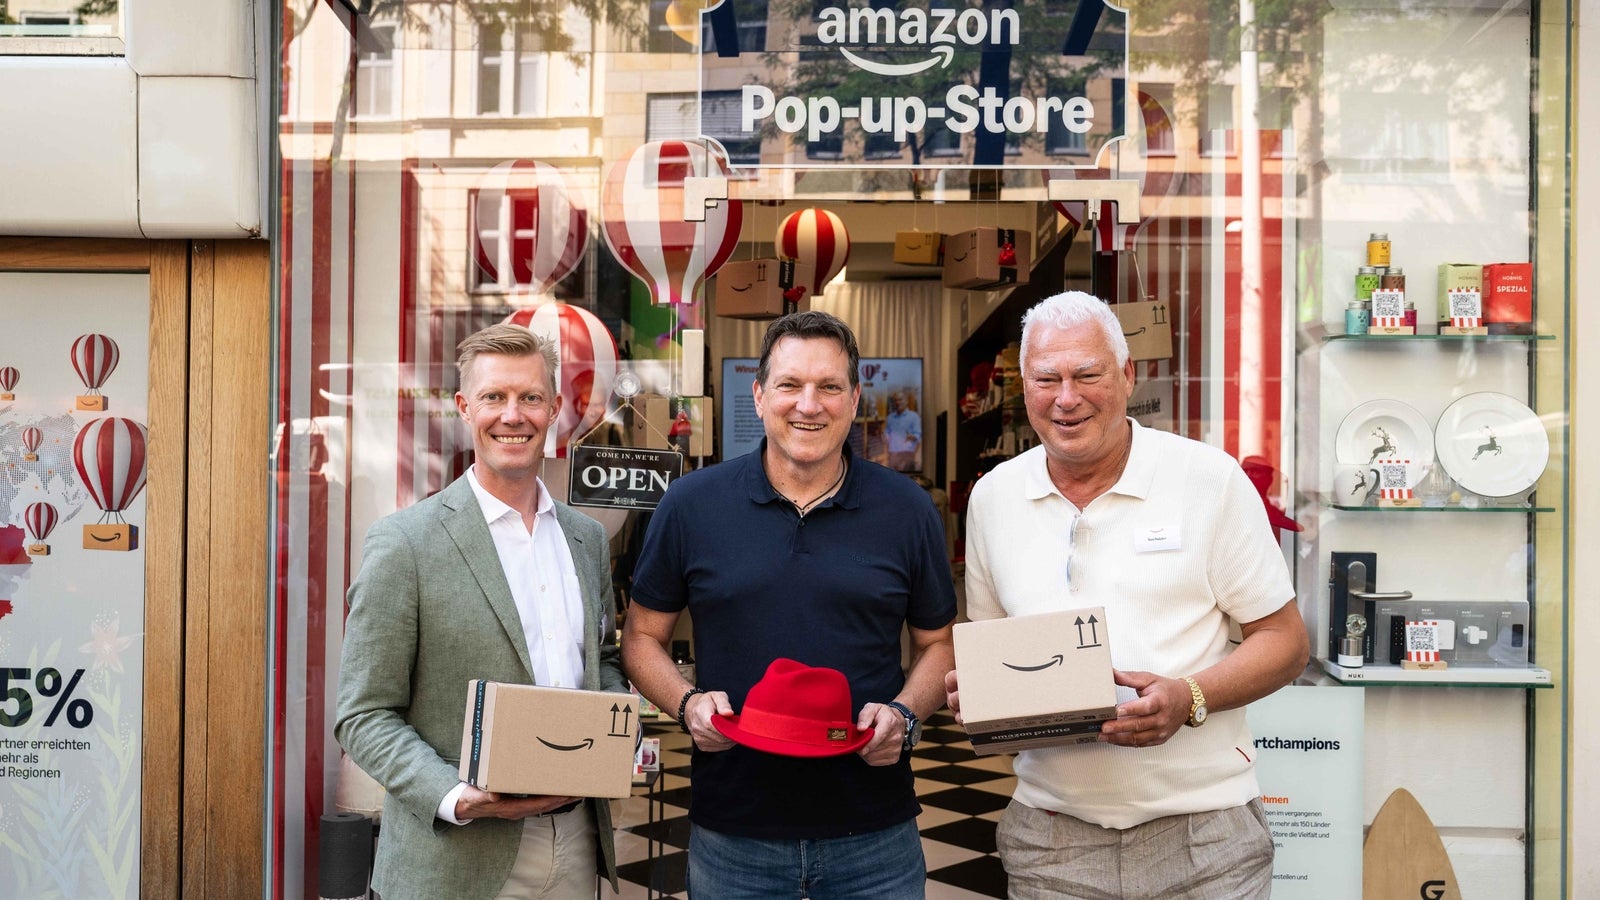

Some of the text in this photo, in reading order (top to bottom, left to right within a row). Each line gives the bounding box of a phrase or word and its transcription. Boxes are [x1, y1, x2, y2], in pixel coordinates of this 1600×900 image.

[817, 7, 1020, 45] amazon
[741, 84, 1095, 142] Pop-up-Store
[596, 451, 620, 459] COME
[581, 465, 672, 493] OPEN
[991, 727, 1071, 741] amazon prime
[31, 739, 91, 751] erreichten
[1253, 737, 1340, 752] rtchampions
[23, 753, 39, 764] als
[8, 766, 61, 780] Regionen
